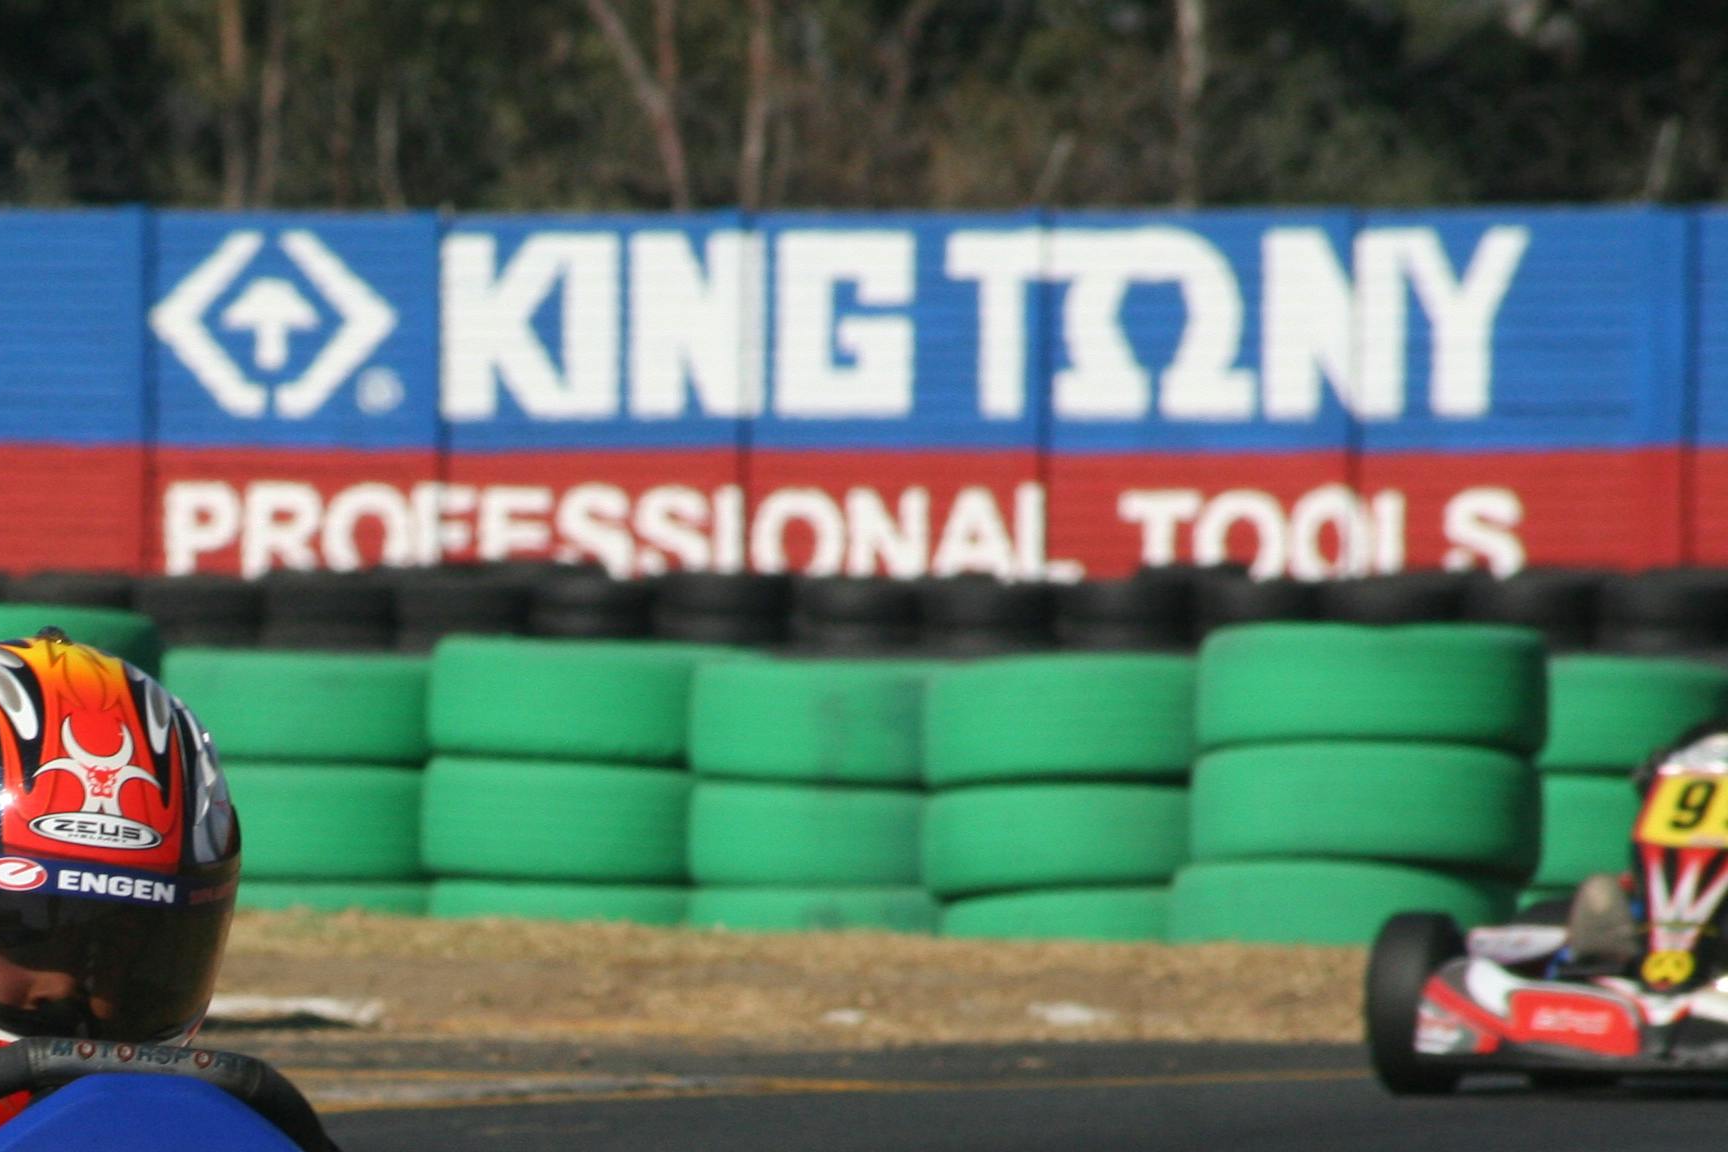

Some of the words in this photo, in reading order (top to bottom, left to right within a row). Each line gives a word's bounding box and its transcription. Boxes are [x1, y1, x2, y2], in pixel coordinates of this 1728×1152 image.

[440, 229, 915, 421] KING
[163, 479, 1085, 584] PROFESSIONAL
[54, 819, 141, 841] ZEUS
[1669, 779, 1728, 831] 9
[57, 869, 176, 904] ENGEN
